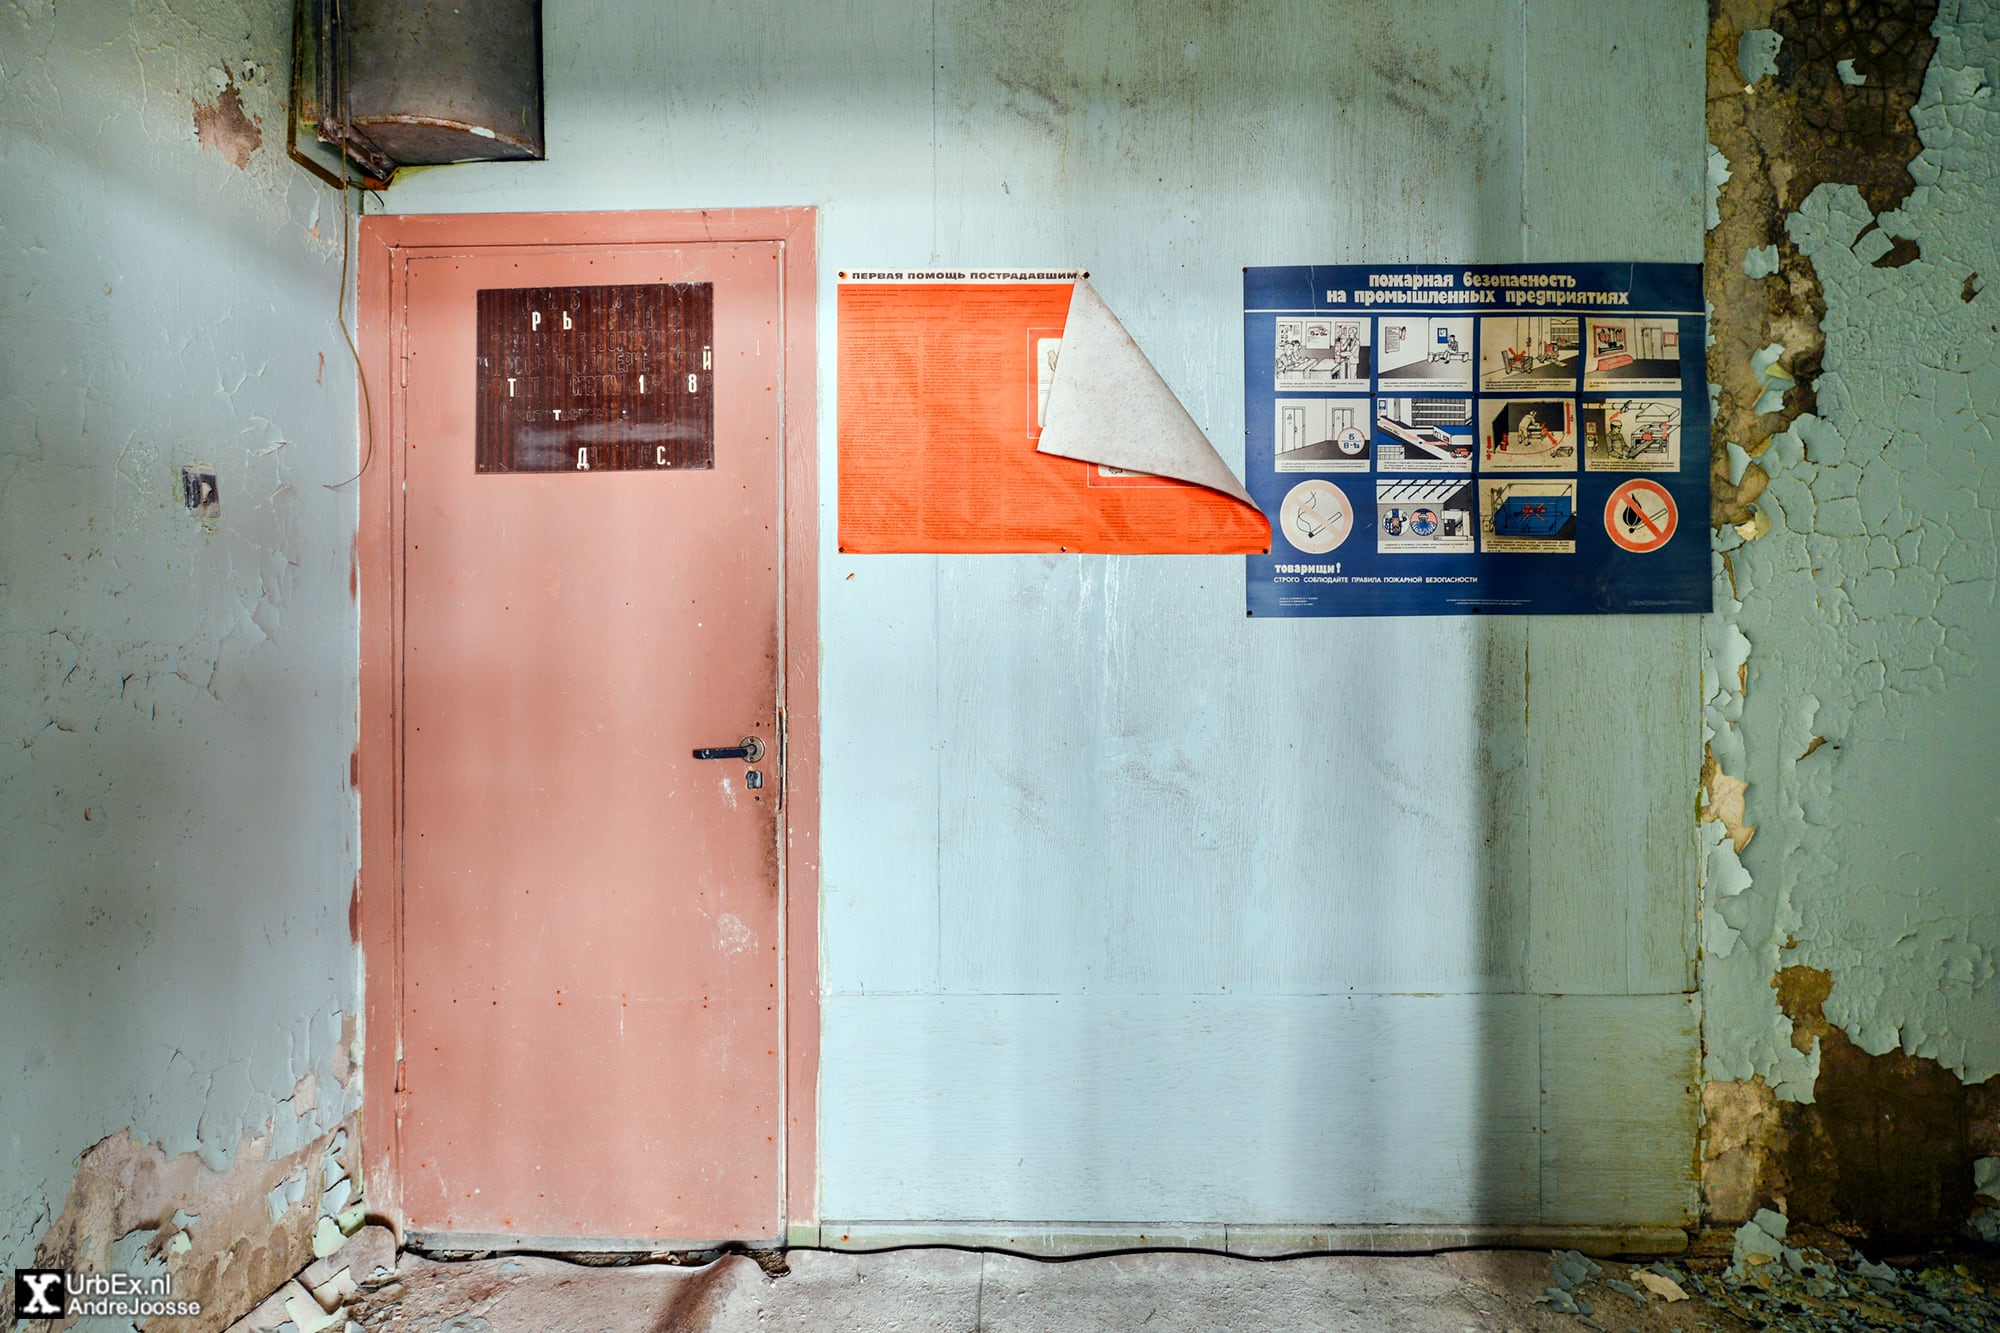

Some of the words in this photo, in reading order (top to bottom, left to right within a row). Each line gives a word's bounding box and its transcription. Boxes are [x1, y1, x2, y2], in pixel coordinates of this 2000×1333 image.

[852, 272, 903, 280] ПЕРВАЯ
[907, 272, 966, 280] ПОМОЩЬ
[970, 272, 1077, 280] ПОСТРАДАВШИМ
[1369, 274, 1454, 290] пожарная
[1463, 271, 1577, 288] безопасность
[1326, 290, 1347, 303] на
[1354, 290, 1496, 306] промышленных
[1505, 290, 1629, 306] предприятиях
[1303, 576, 1349, 584] СОБЛЮДАЙТЕ
[1383, 576, 1423, 584] ПОЖАРНОЙ
[1425, 576, 1478, 584] БЕЗОПАСНОСТИ
